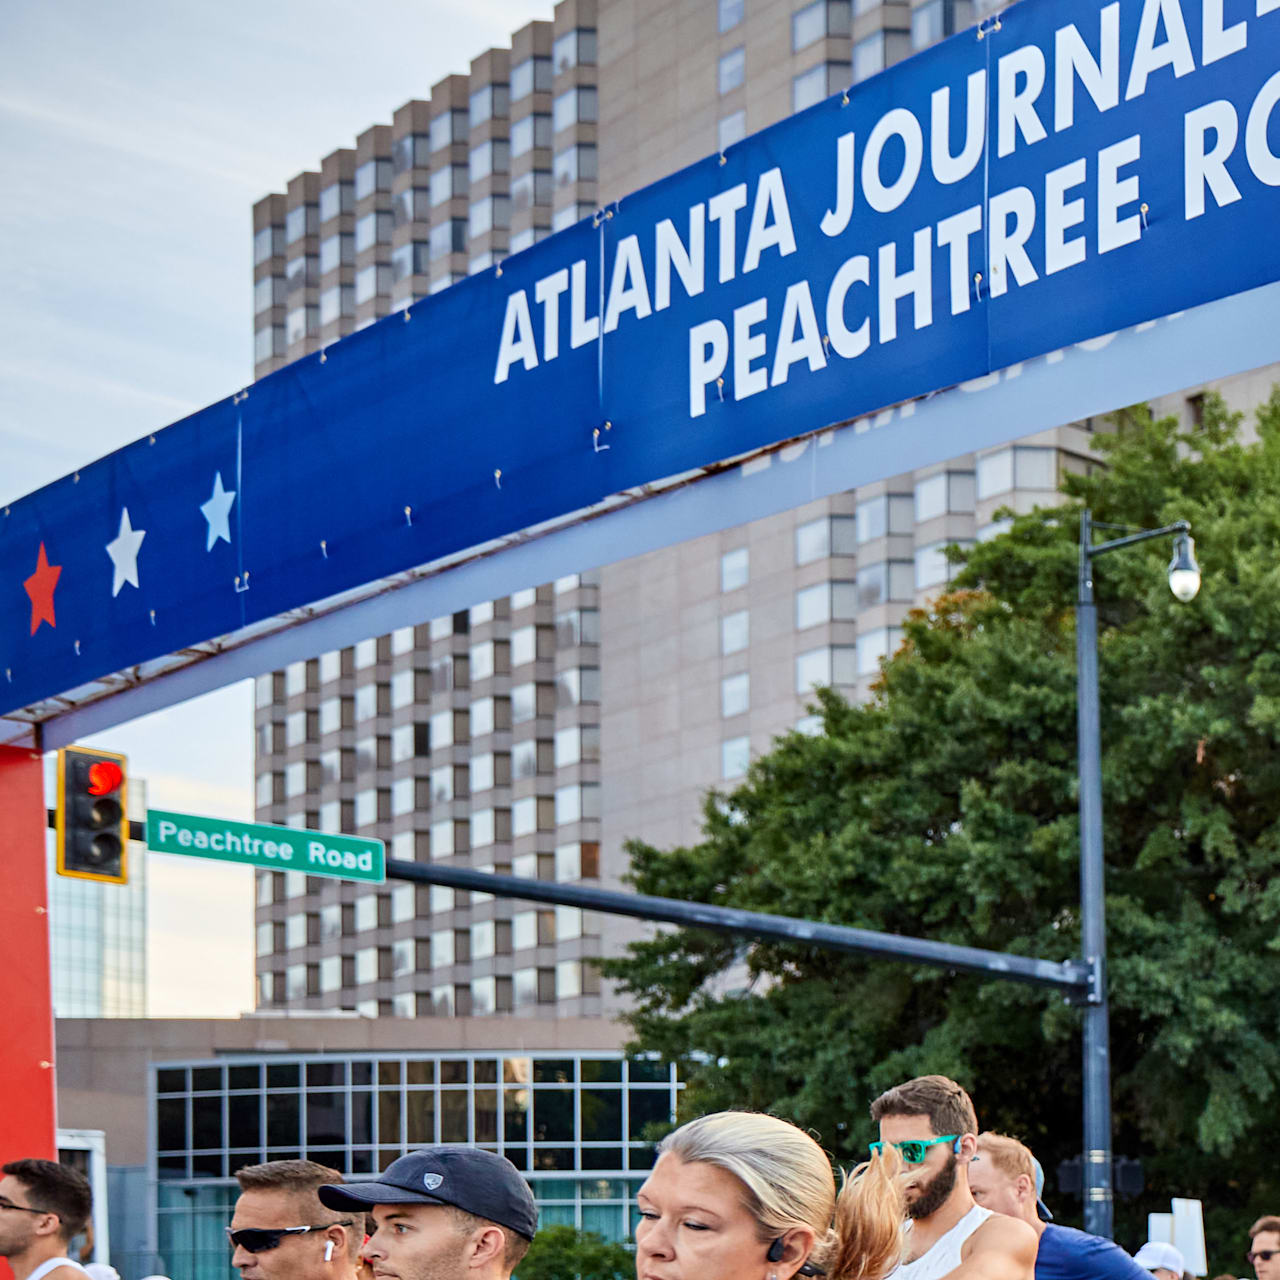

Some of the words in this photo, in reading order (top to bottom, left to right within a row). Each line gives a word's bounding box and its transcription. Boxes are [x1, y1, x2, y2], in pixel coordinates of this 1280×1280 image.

[494, 167, 797, 385] ATLANTA
[690, 135, 1141, 418] PEACHTREE
[158, 820, 295, 861] Peachtree
[308, 842, 374, 872] Road
